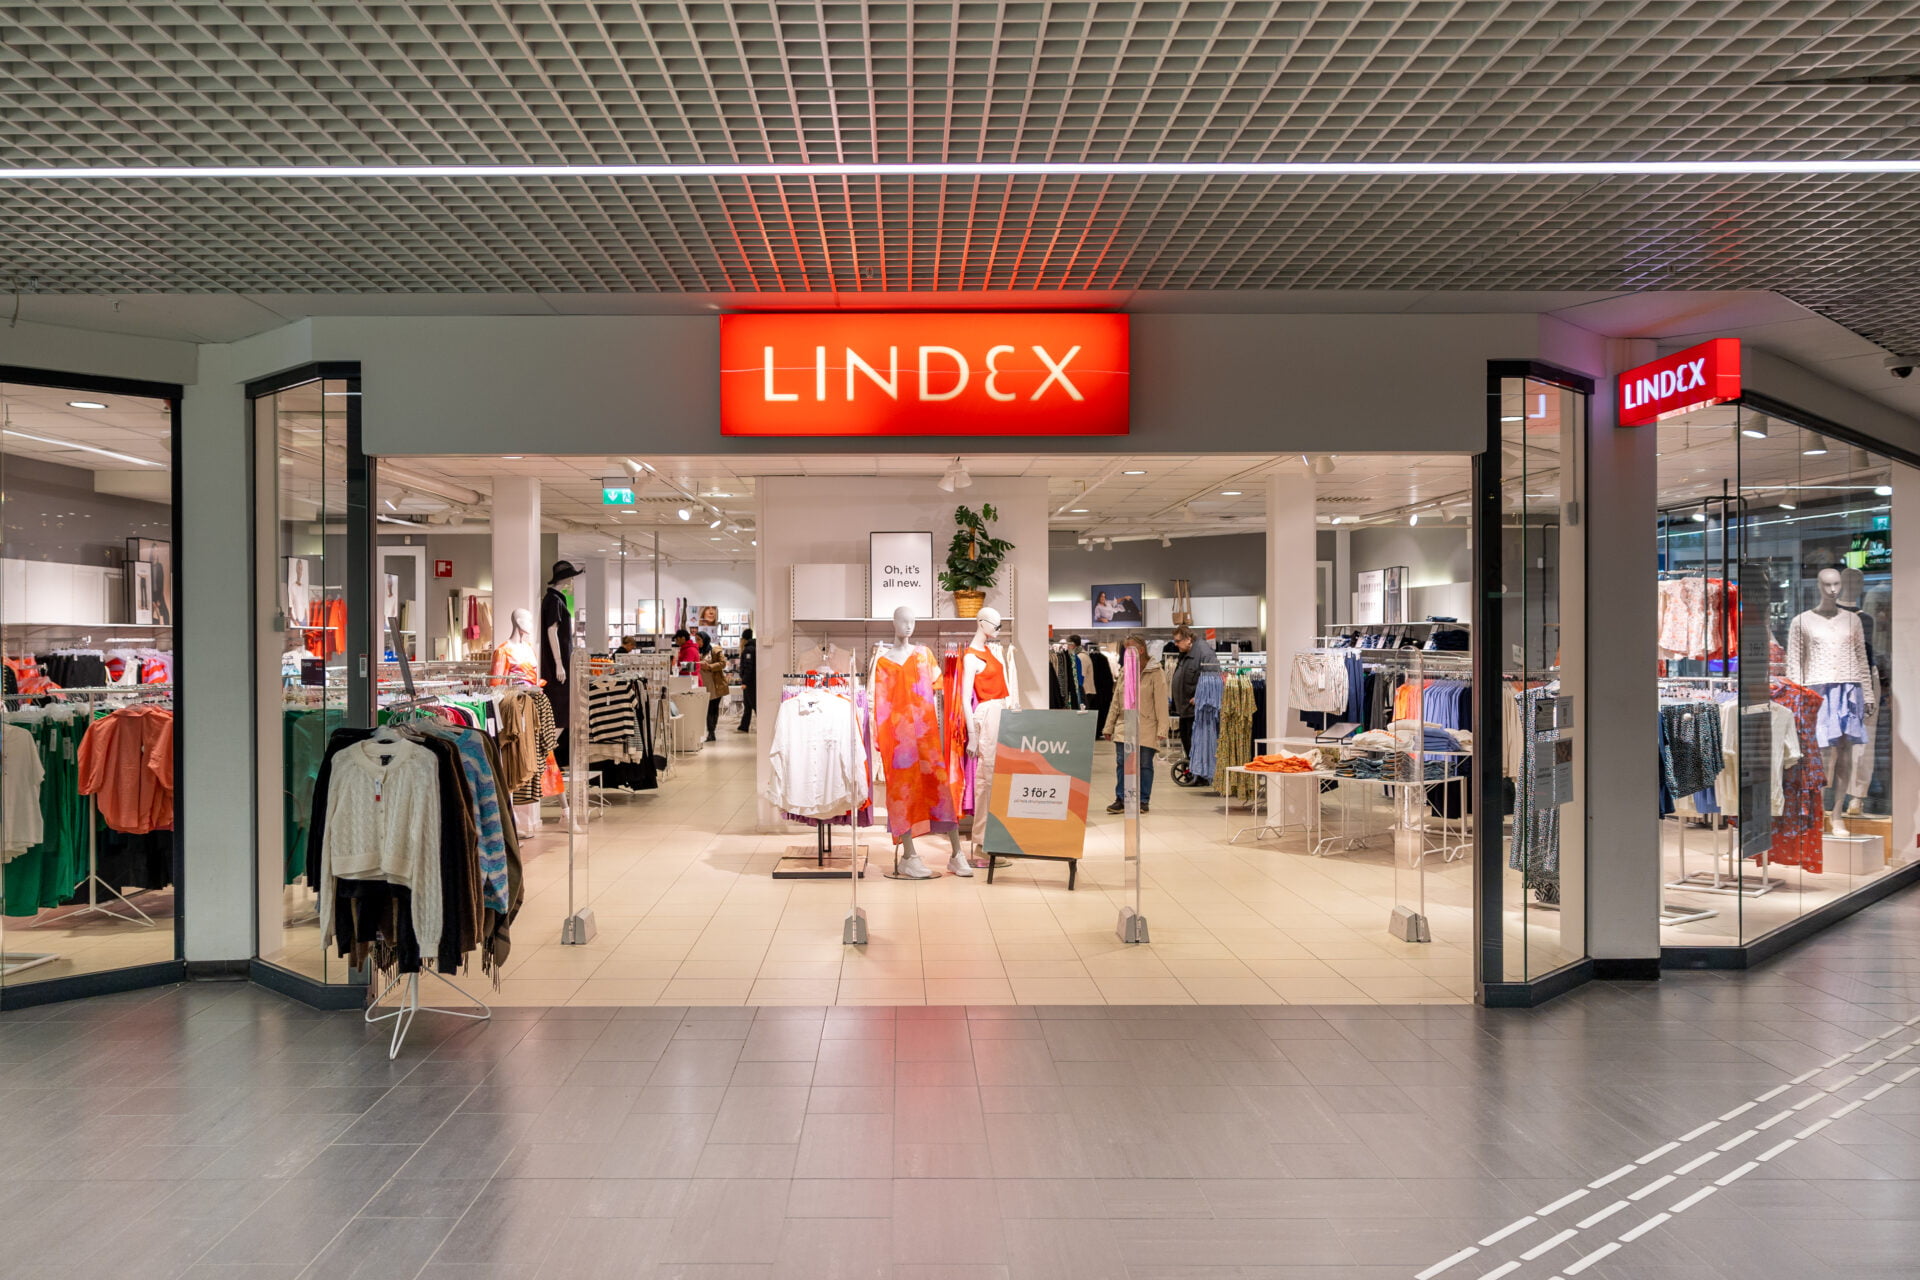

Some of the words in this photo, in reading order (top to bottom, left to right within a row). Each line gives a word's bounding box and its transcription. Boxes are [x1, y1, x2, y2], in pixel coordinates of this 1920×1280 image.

[764, 345, 1086, 402] LINDEX
[1624, 357, 1706, 410] LINDEX
[884, 565, 903, 575] Oh,
[905, 564, 920, 574] it's
[882, 579, 895, 588] all
[896, 580, 921, 588] new.
[1020, 735, 1070, 755] Now.
[1022, 787, 1029, 798] 3
[1031, 787, 1048, 798] för
[1049, 788, 1057, 798] 2
